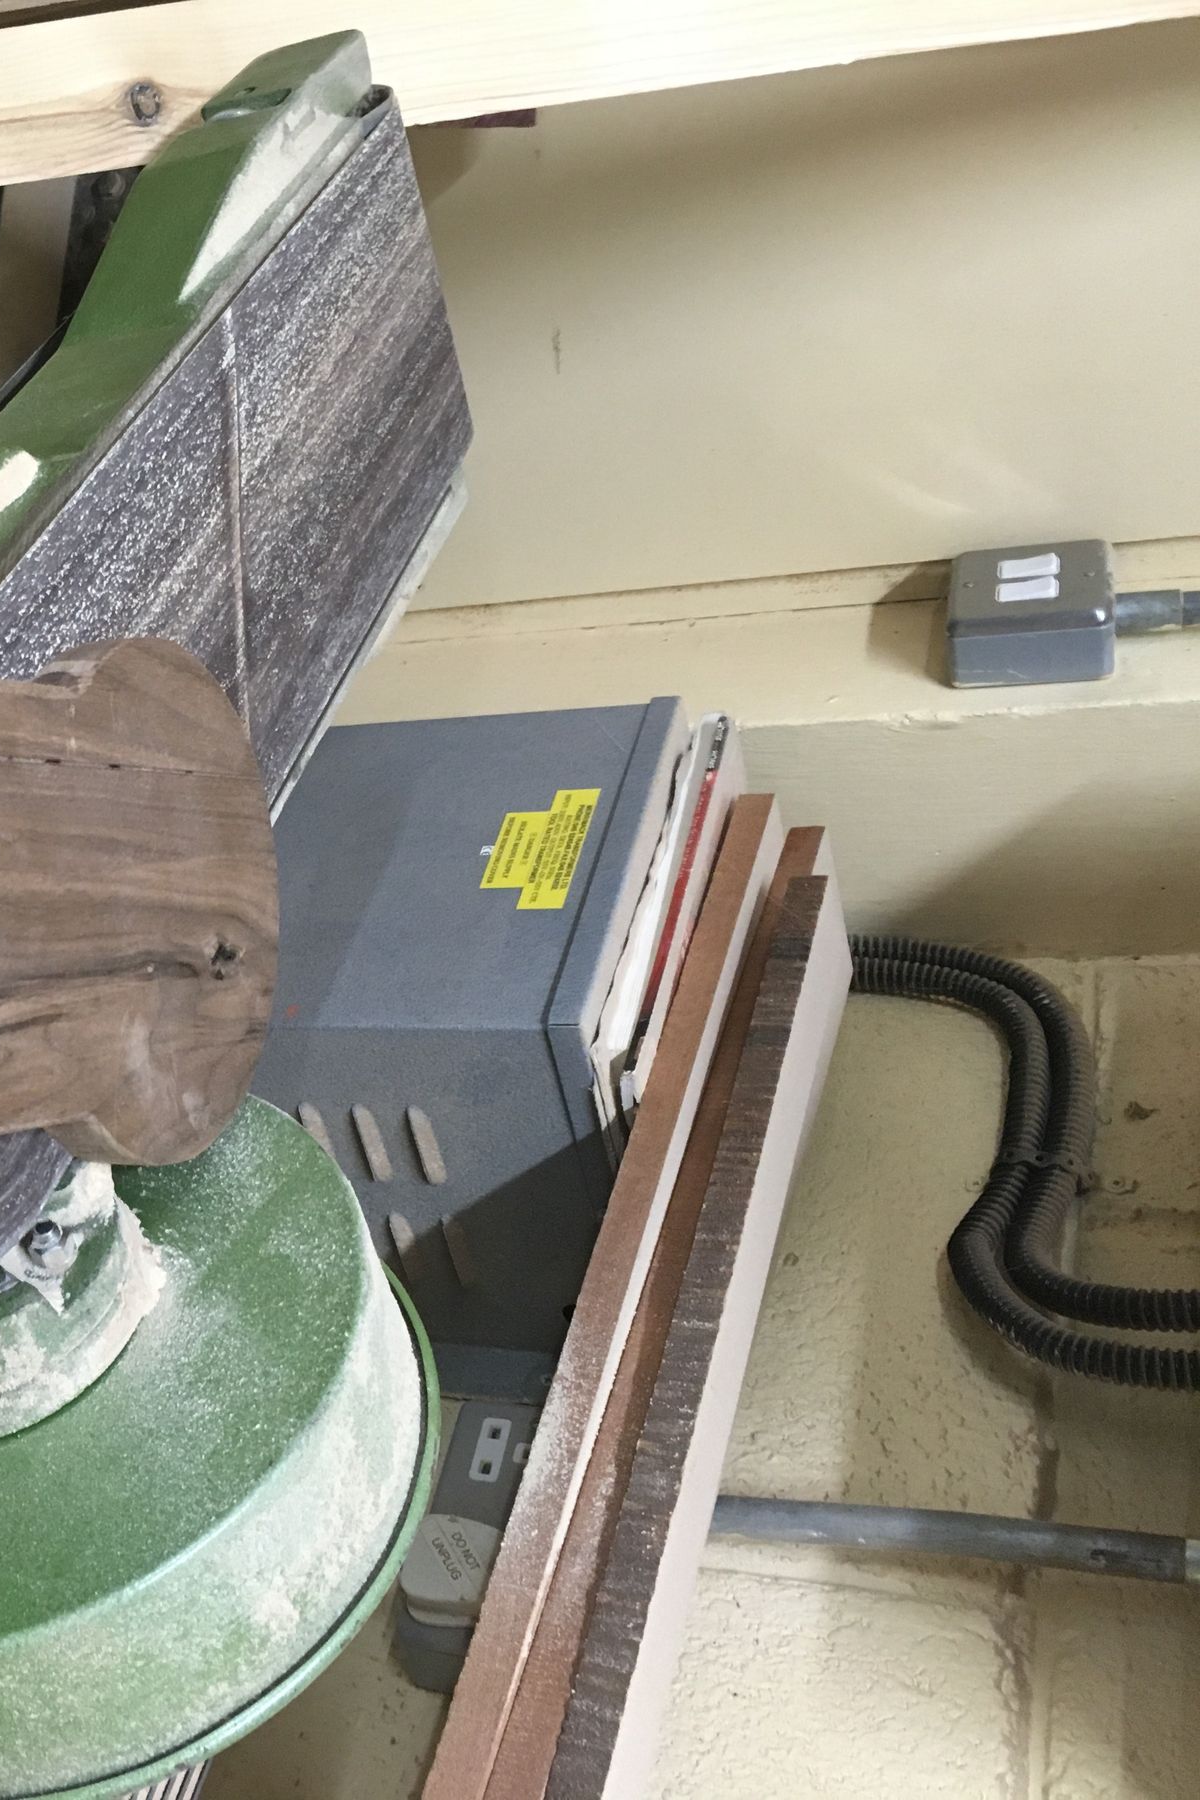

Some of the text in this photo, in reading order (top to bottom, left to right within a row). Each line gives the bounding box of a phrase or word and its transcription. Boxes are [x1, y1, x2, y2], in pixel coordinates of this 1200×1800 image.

[431, 1537, 462, 1581] UNPLUG
[451, 1531, 481, 1570] DO NOT
